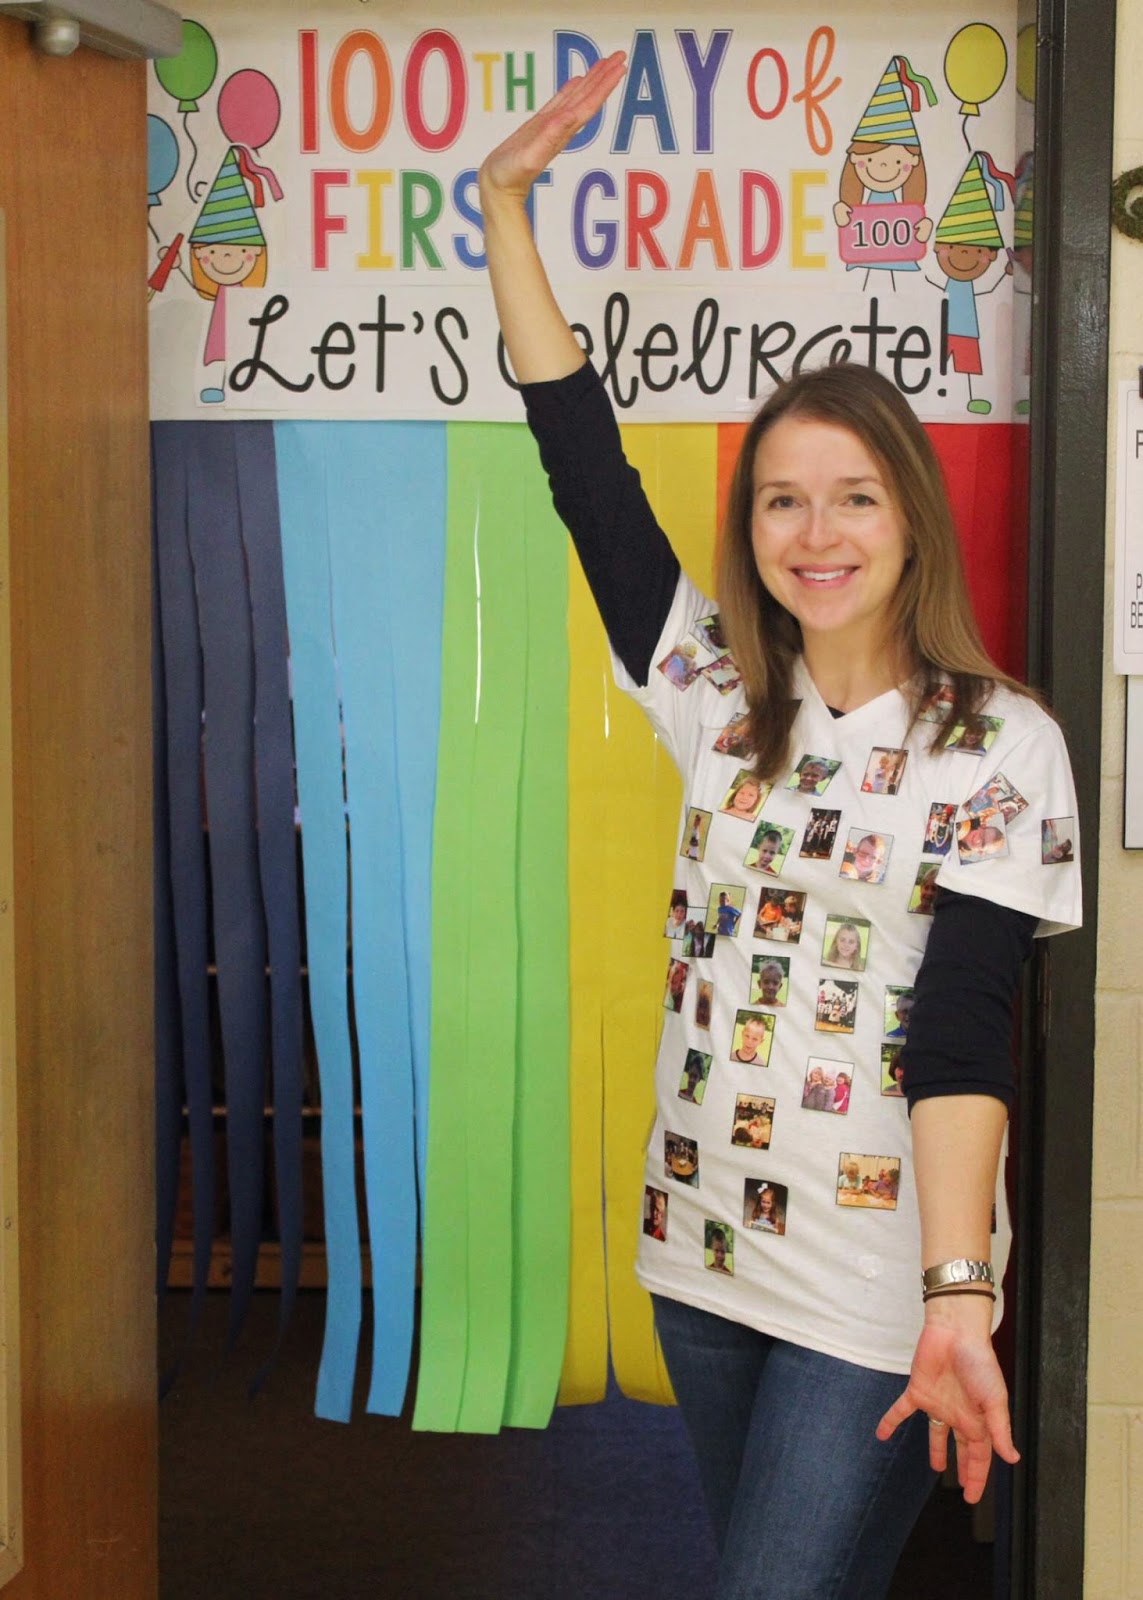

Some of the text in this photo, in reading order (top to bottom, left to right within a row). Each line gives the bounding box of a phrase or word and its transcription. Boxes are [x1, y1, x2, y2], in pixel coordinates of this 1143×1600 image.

[553, 29, 733, 154] DAY
[571, 168, 829, 271] GRADE
[851, 218, 912, 249] 100
[228, 294, 468, 406] Let's
